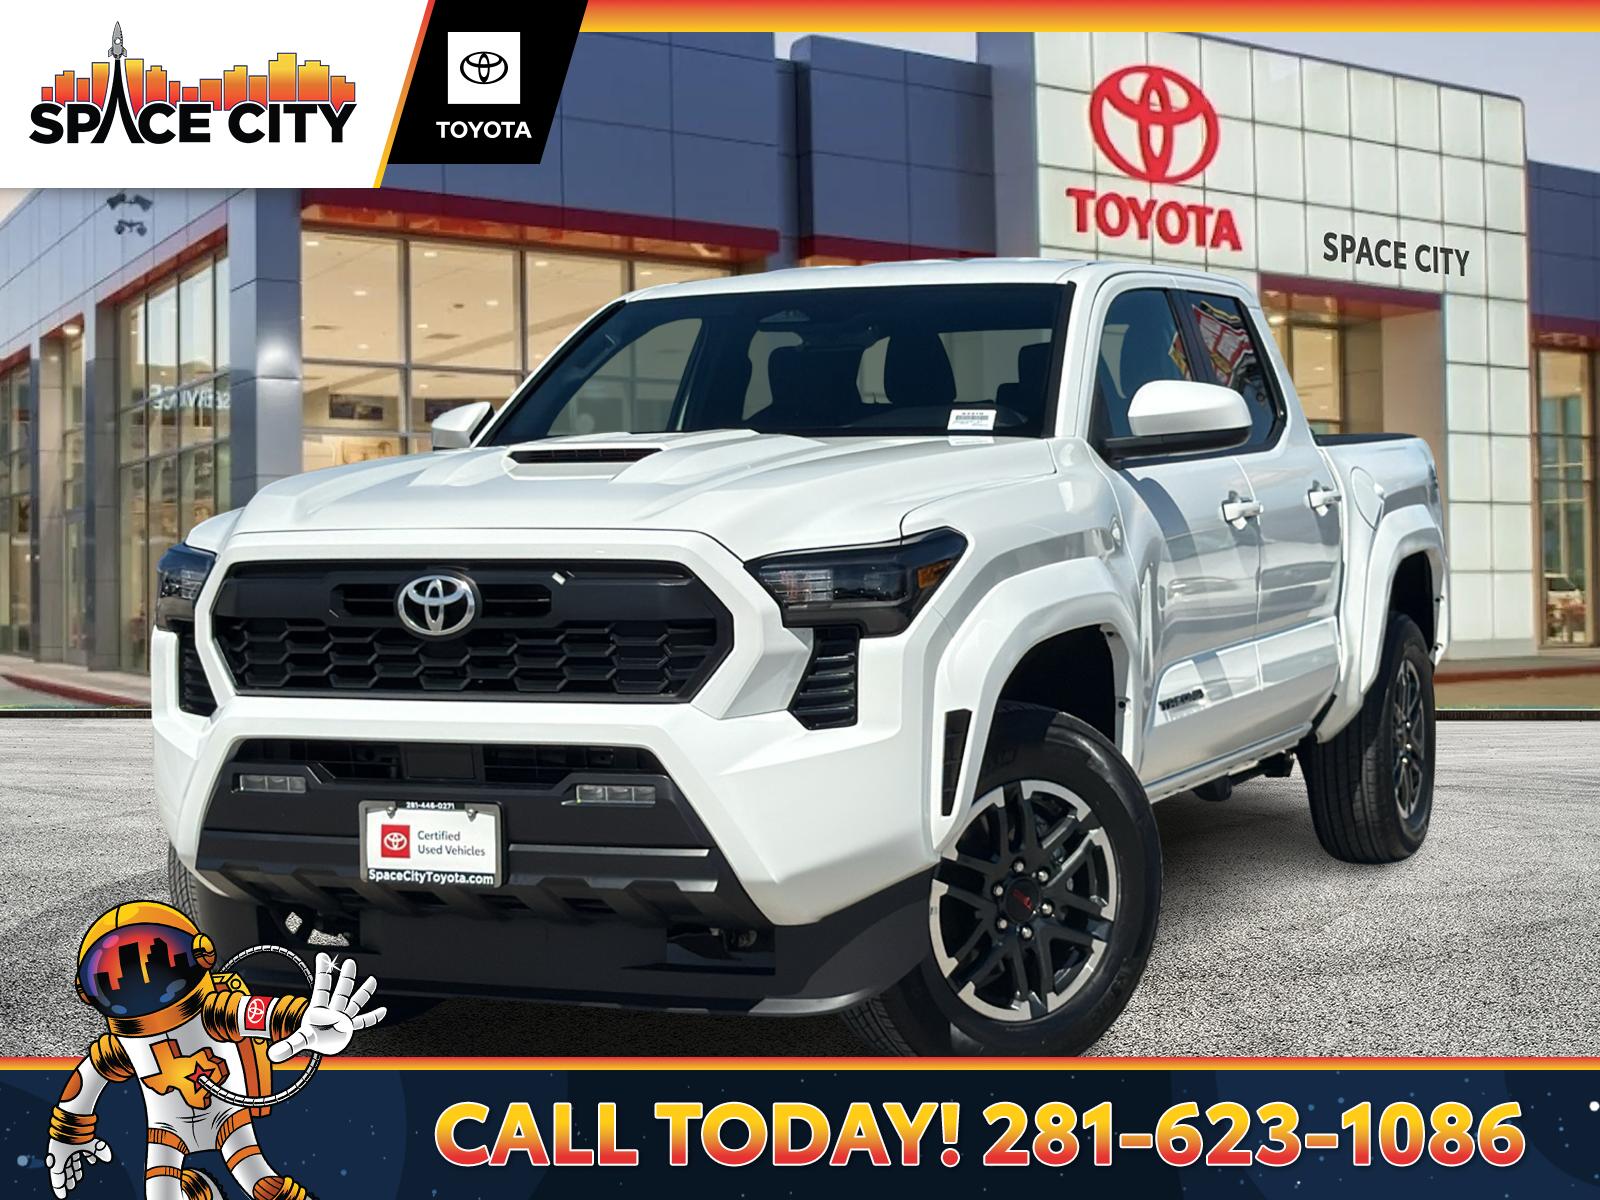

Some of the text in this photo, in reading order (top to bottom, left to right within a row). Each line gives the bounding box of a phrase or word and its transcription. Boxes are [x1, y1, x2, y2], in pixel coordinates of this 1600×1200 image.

[1065, 187, 1242, 251] TOYOTA
[1323, 232, 1470, 277] SPACE CITY
[417, 830, 461, 842] Certified
[417, 844, 486, 857] Used Vehicles
[368, 869, 494, 885] SpaceCityToyota.com
